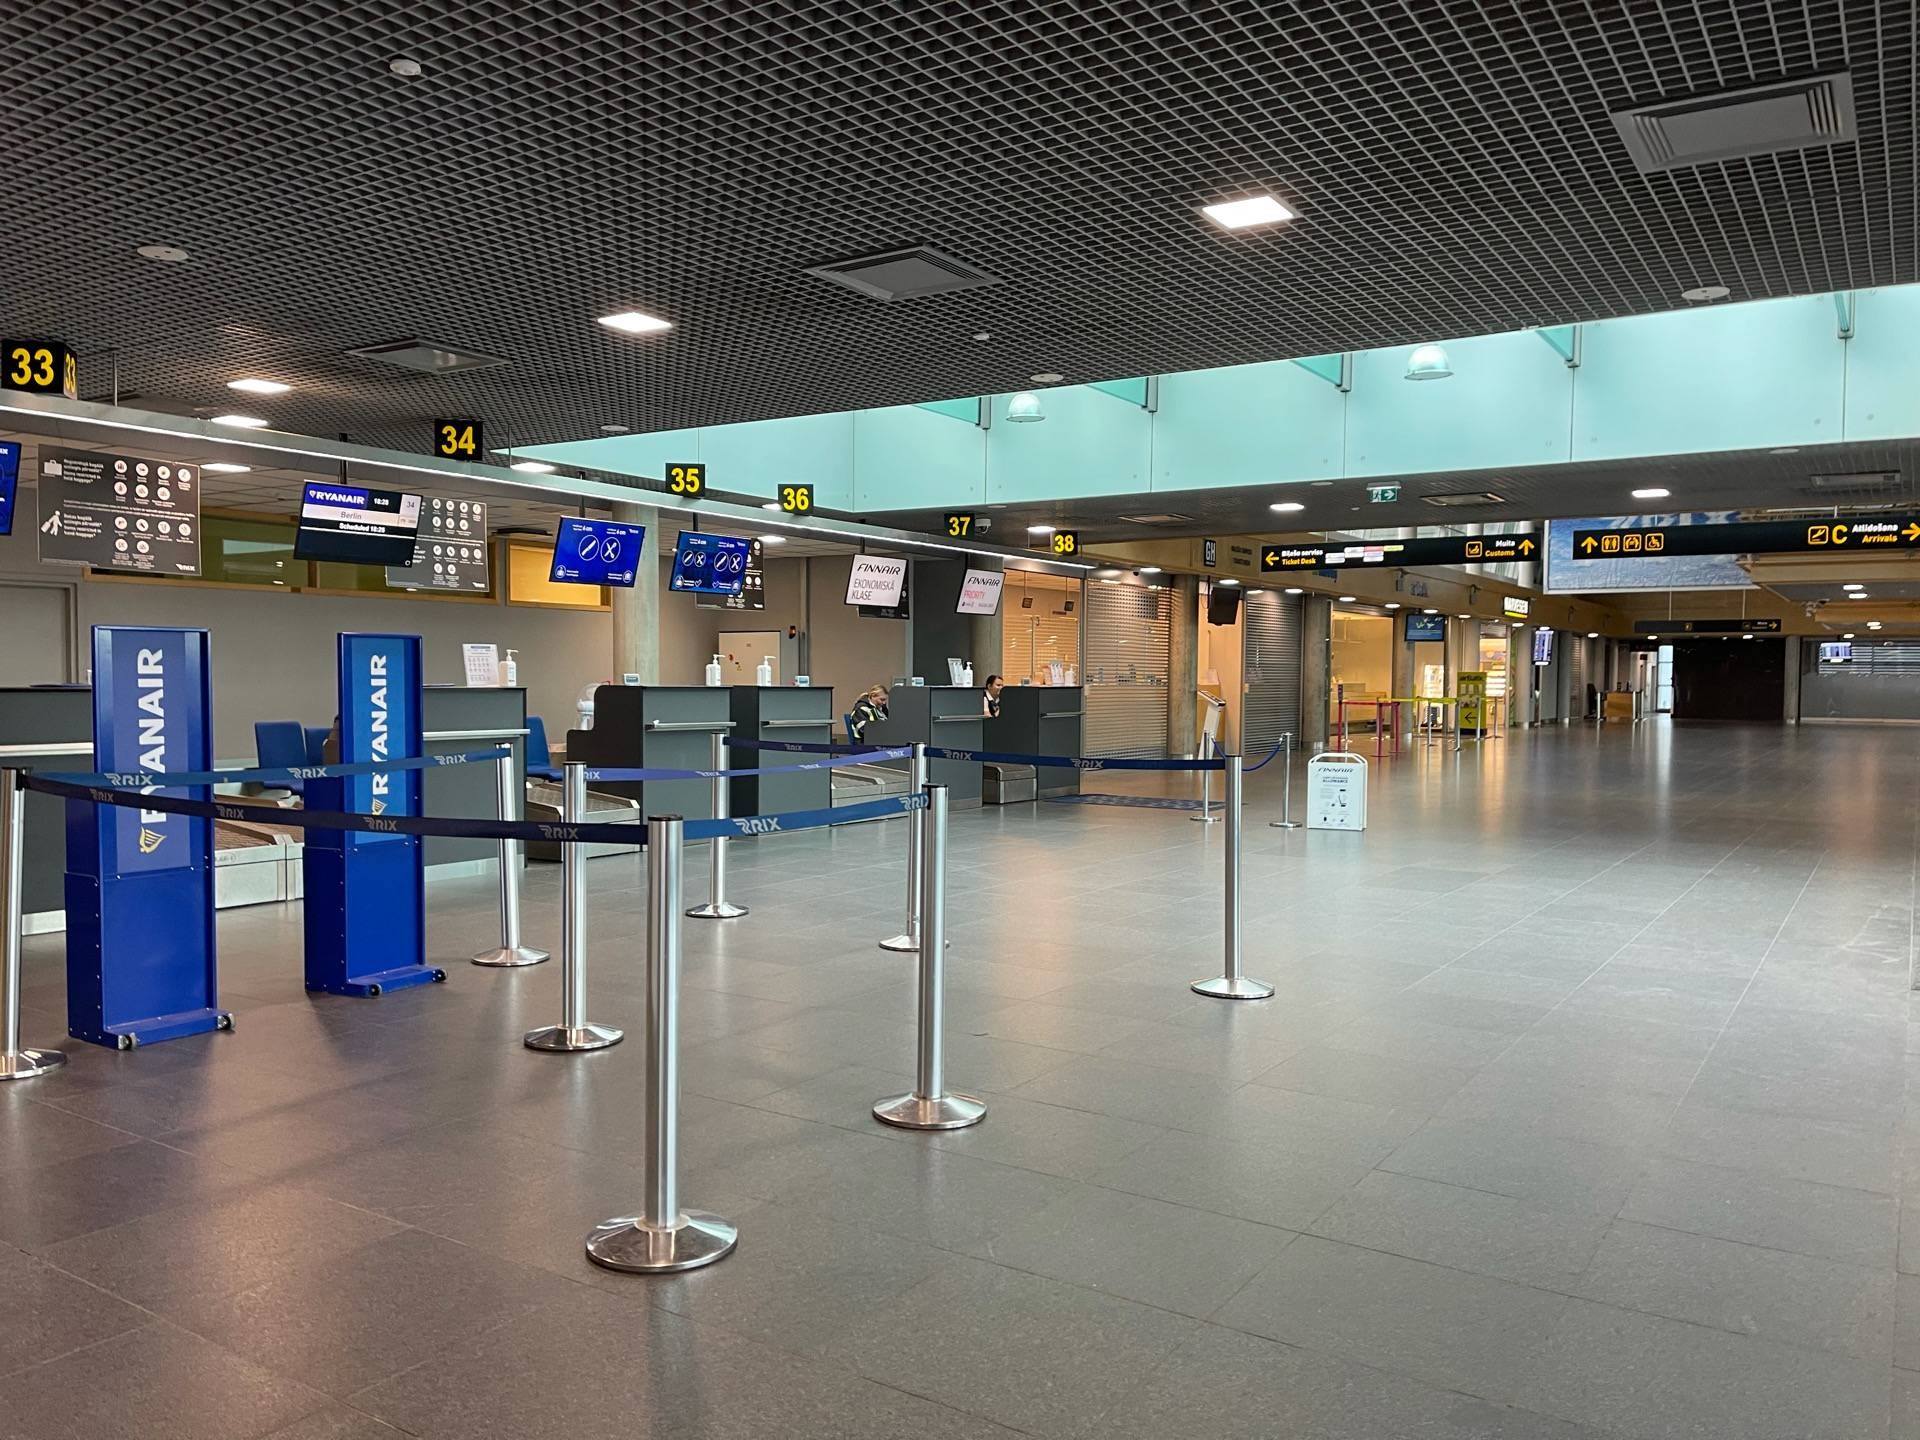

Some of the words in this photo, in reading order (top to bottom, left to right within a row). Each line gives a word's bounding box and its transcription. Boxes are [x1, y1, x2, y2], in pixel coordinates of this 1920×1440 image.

[11, 348, 54, 386] 33
[441, 425, 476, 455] 34
[670, 467, 700, 493] 35
[316, 493, 365, 505] RYANAIR
[406, 500, 415, 508] 34
[783, 487, 809, 511] 36
[340, 511, 362, 520] Berlin
[949, 516, 971, 536] 37
[1832, 524, 1848, 545] C
[1862, 534, 1898, 544] Arrivals
[1054, 534, 1075, 553] 38
[1205, 541, 1216, 562] GH
[857, 563, 901, 575] FINNAIR
[967, 576, 1000, 587] FINNAIR
[851, 589, 872, 600] KLASE
[302, 767, 327, 778] RIX
[122, 774, 153, 786] RIX
[752, 817, 781, 833] RIX
[552, 827, 579, 839] RIX
